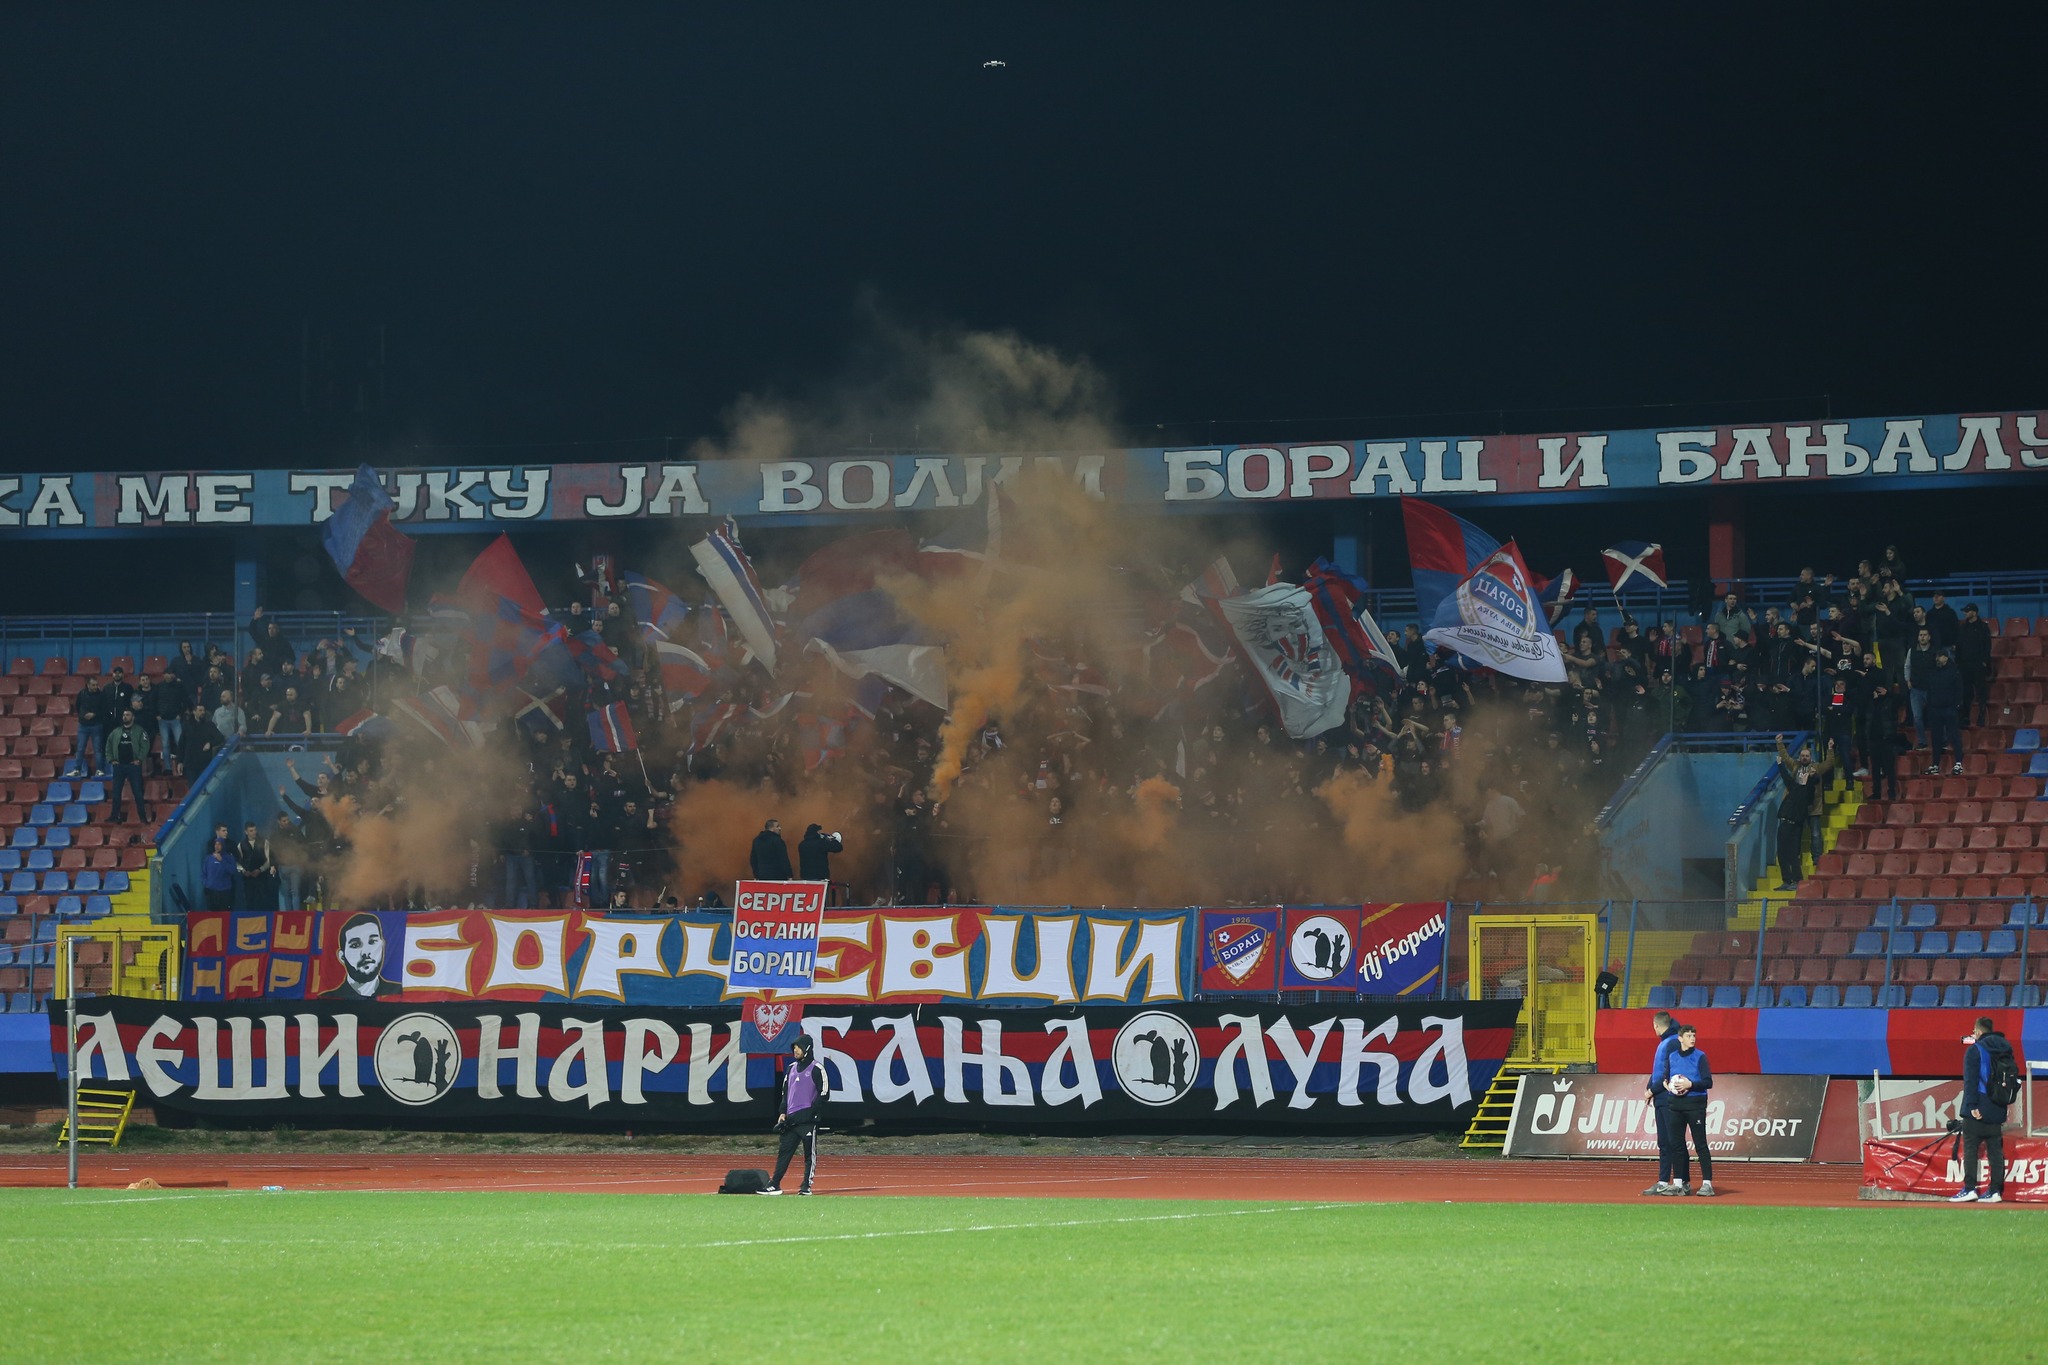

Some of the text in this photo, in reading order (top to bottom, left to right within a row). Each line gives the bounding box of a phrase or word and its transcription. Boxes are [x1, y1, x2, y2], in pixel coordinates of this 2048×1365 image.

[116, 474, 252, 524] МЕ
[586, 465, 710, 517] ЈА
[1164, 440, 1497, 502] БОРАЦ
[1537, 434, 1609, 489] И
[739, 892, 819, 912] СЕРГЕЈ
[736, 920, 816, 940] ОСТАНИ
[1380, 913, 1446, 965] Борац
[1221, 932, 1261, 961] БОРАЦ
[733, 950, 812, 979] БОРАЦ
[1578, 1093, 1802, 1137] Juvea SPORT
